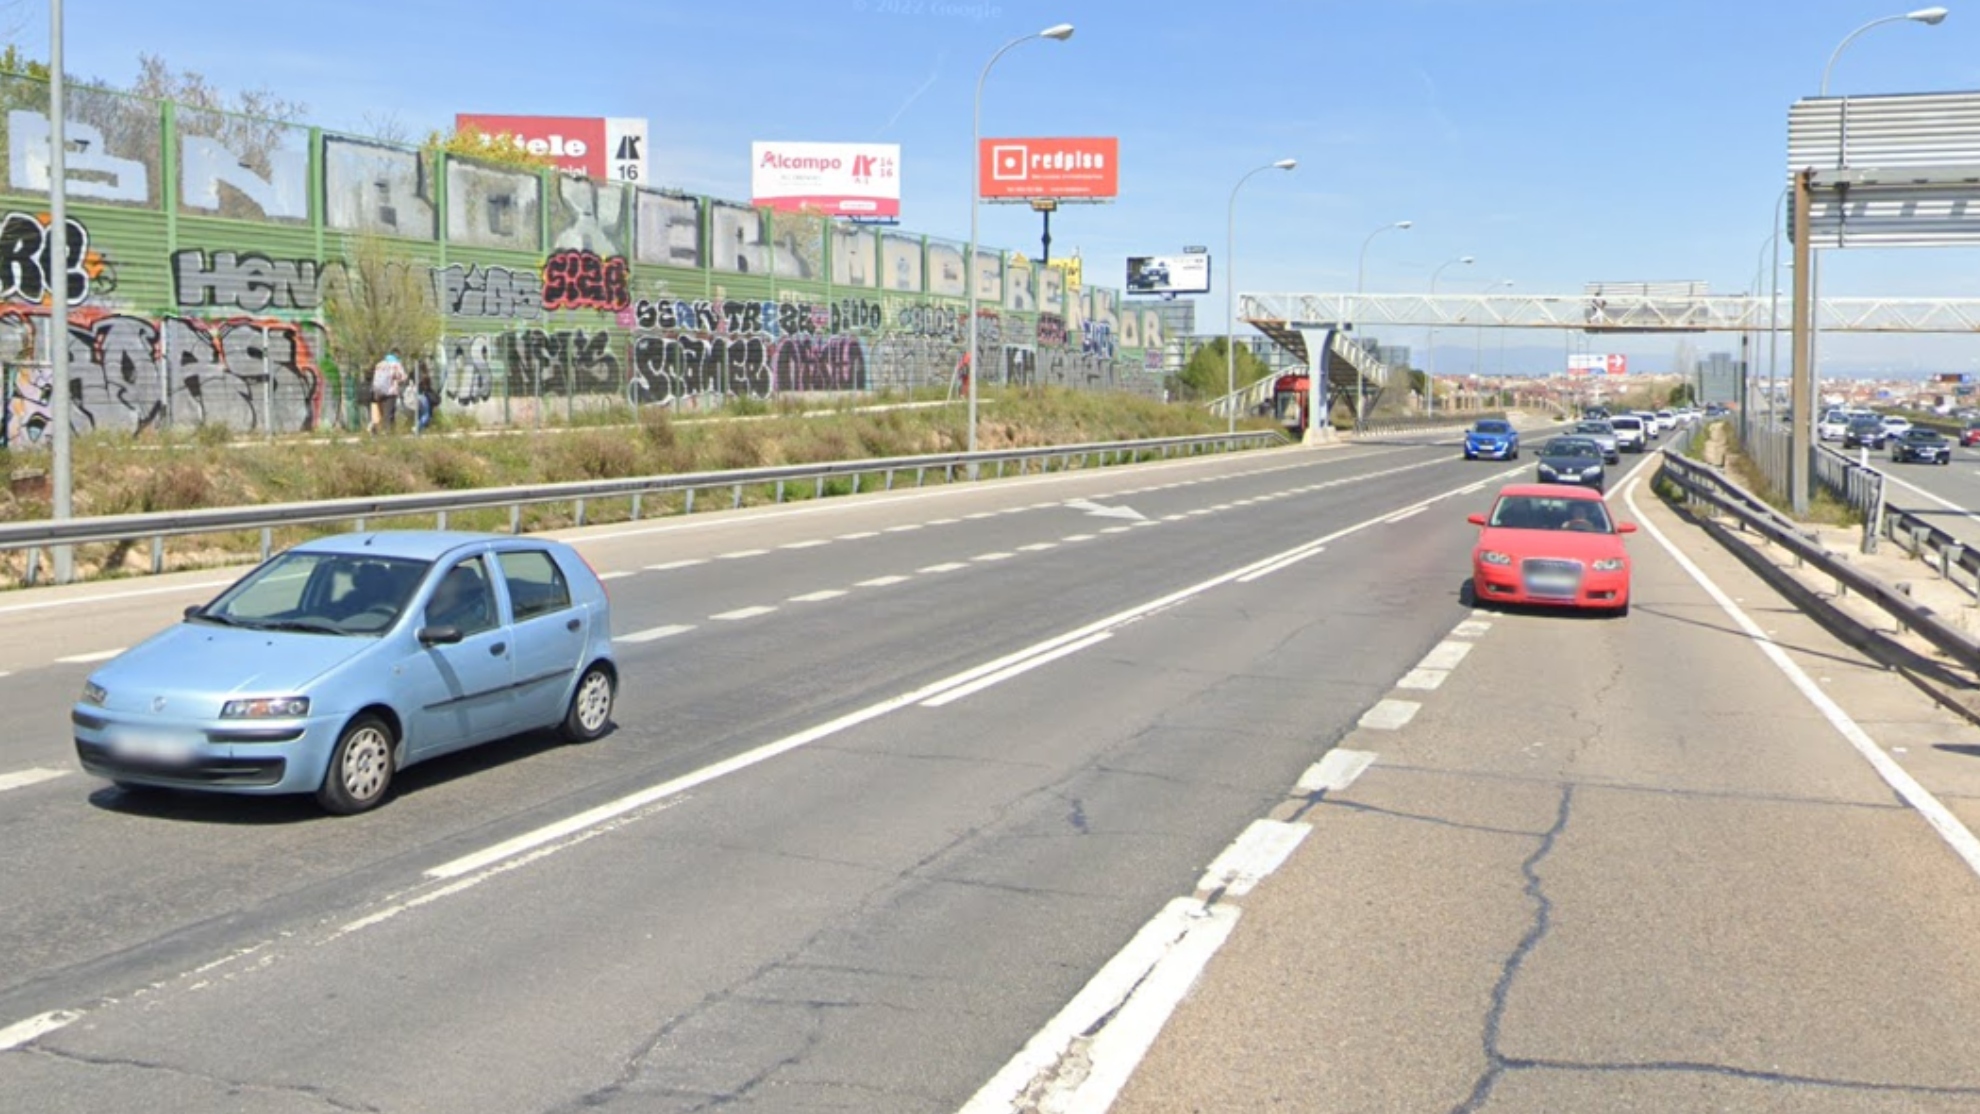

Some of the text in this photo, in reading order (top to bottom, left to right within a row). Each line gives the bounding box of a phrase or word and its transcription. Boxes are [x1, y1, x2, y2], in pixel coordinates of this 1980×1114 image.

[761, 151, 842, 171] Alcampo
[1031, 150, 1104, 171] redpiso
[619, 165, 639, 180] 16
[881, 169, 893, 178] 16
